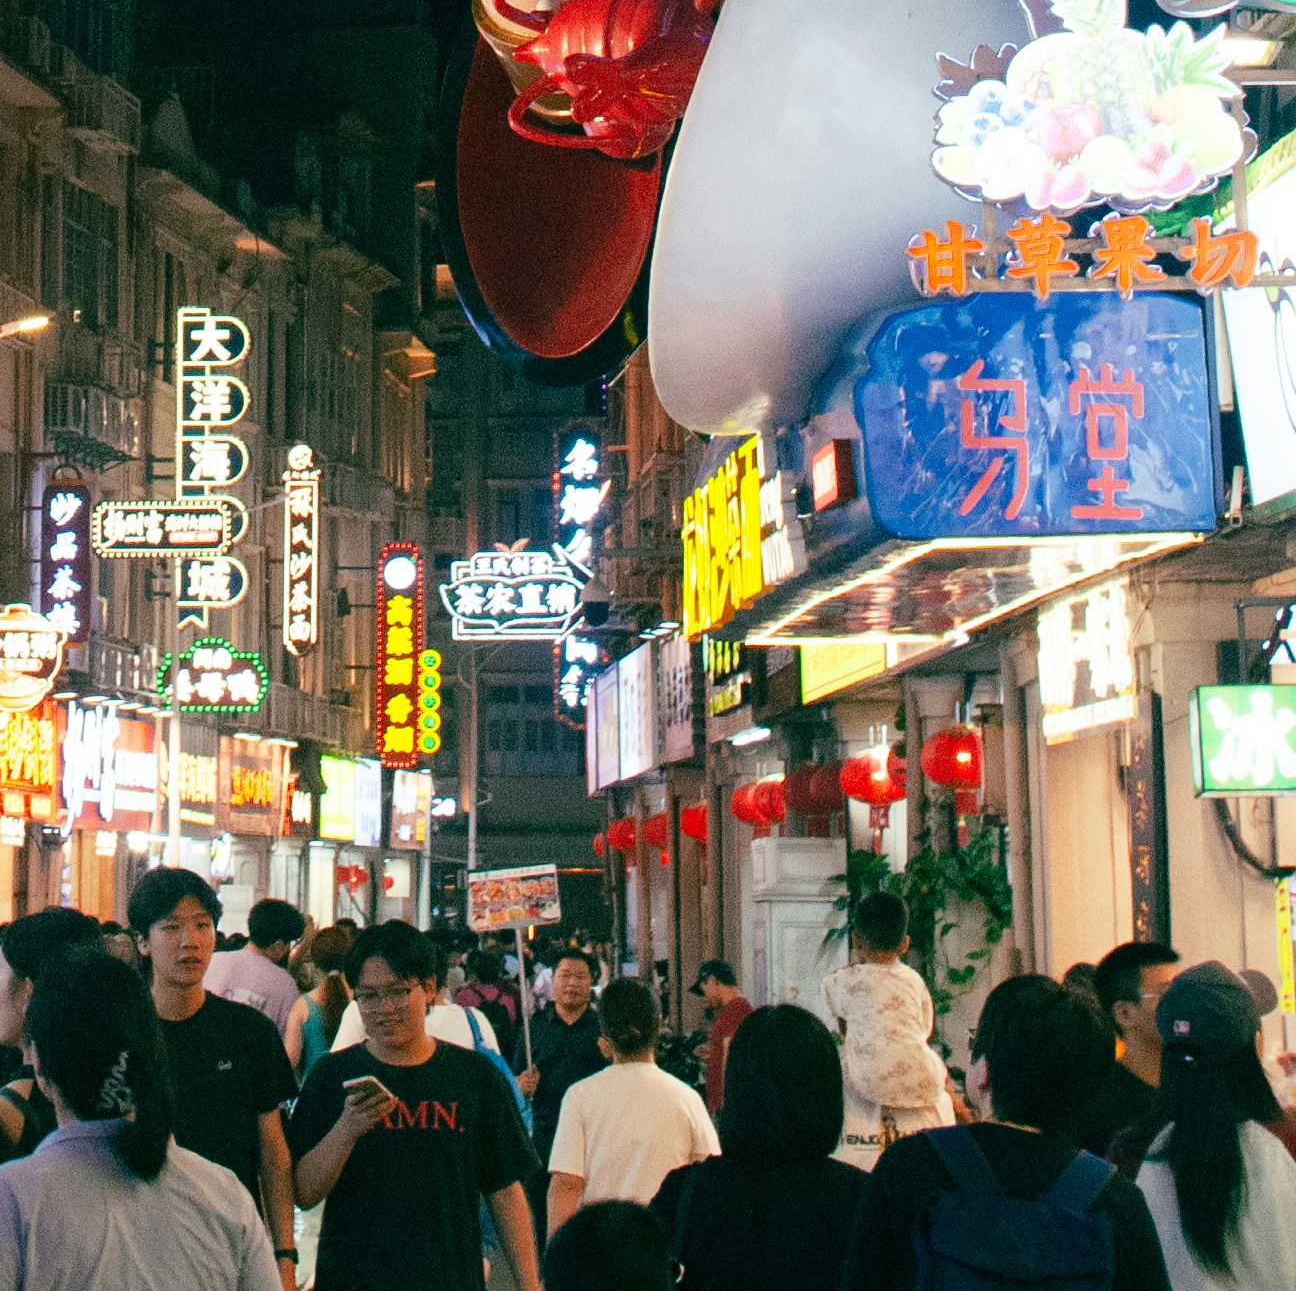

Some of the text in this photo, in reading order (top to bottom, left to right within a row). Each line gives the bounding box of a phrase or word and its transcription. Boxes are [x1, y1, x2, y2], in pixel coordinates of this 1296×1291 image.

[907, 214, 1261, 300] 甘草果切
[189, 321, 232, 601] 大洋海城
[453, 582, 577, 616] 茶农直销
[1205, 690, 1296, 787] 冰
